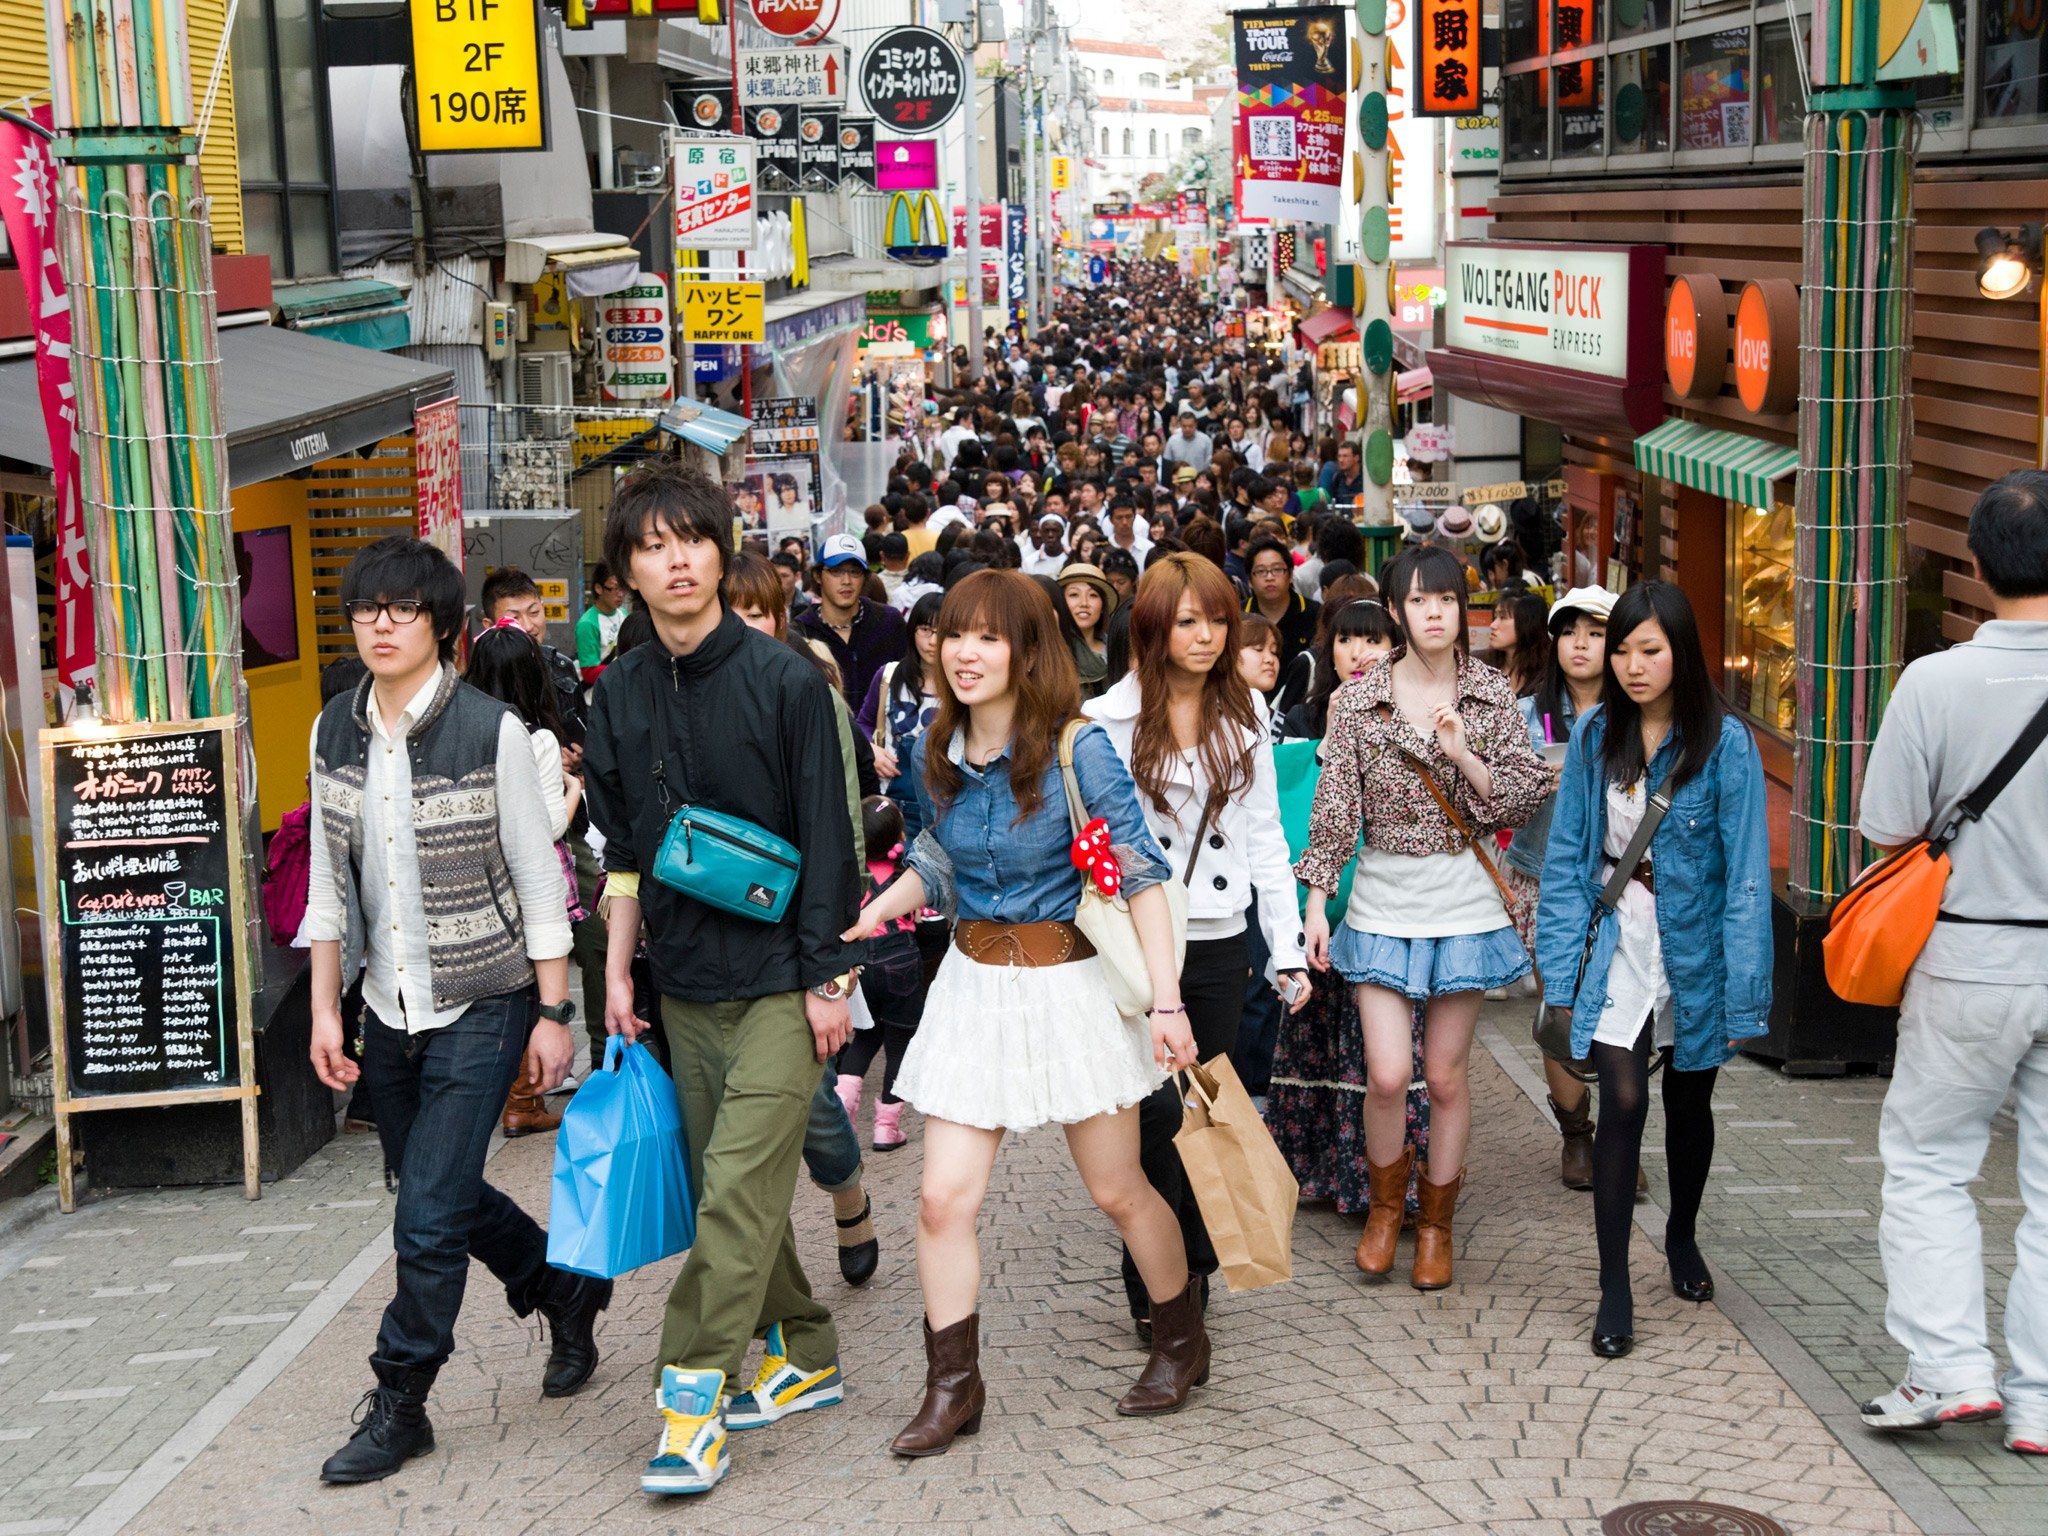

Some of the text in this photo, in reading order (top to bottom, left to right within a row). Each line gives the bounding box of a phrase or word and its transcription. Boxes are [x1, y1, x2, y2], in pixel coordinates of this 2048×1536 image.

[1243, 20, 1265, 29] FIFA
[1246, 28, 1288, 37] TROPHY
[1246, 36, 1290, 51] TOUR
[1432, 0, 1469, 101] 野家
[463, 43, 505, 72] 2F
[746, 54, 821, 77] 東郷神社
[878, 45, 942, 69] コミック &
[746, 75, 822, 98] 東郷記念館
[867, 69, 957, 99] インターネットカフェ
[430, 87, 527, 125] 190席
[895, 100, 934, 122] 2F
[1301, 109, 1330, 123] 4.25
[687, 147, 737, 165] 原宿
[757, 145, 798, 159] LPHA
[801, 150, 838, 162] LPHA
[840, 156, 874, 168] LPHA
[681, 167, 747, 201] アイドル
[1273, 195, 1320, 206] Takeshita st.
[677, 192, 751, 233] 写真センター
[686, 286, 762, 305] ハッピー
[1461, 263, 1603, 319] WOLFGANG PUCK
[707, 308, 743, 326] ワン
[611, 329, 660, 342] ポスター
[693, 329, 754, 340] HAPPY ONE
[860, 318, 908, 342] id's
[1670, 317, 1694, 359] live
[1553, 328, 1602, 356] EXPRESS
[1737, 325, 1769, 372] love
[693, 360, 718, 371] PEN
[618, 373, 663, 385] こちらです
[290, 431, 330, 461] LOTTERIA
[171, 768, 212, 781] イタリアン
[73, 770, 163, 800] オーガニック
[172, 781, 217, 795] レストラン
[189, 888, 225, 907] BAR
